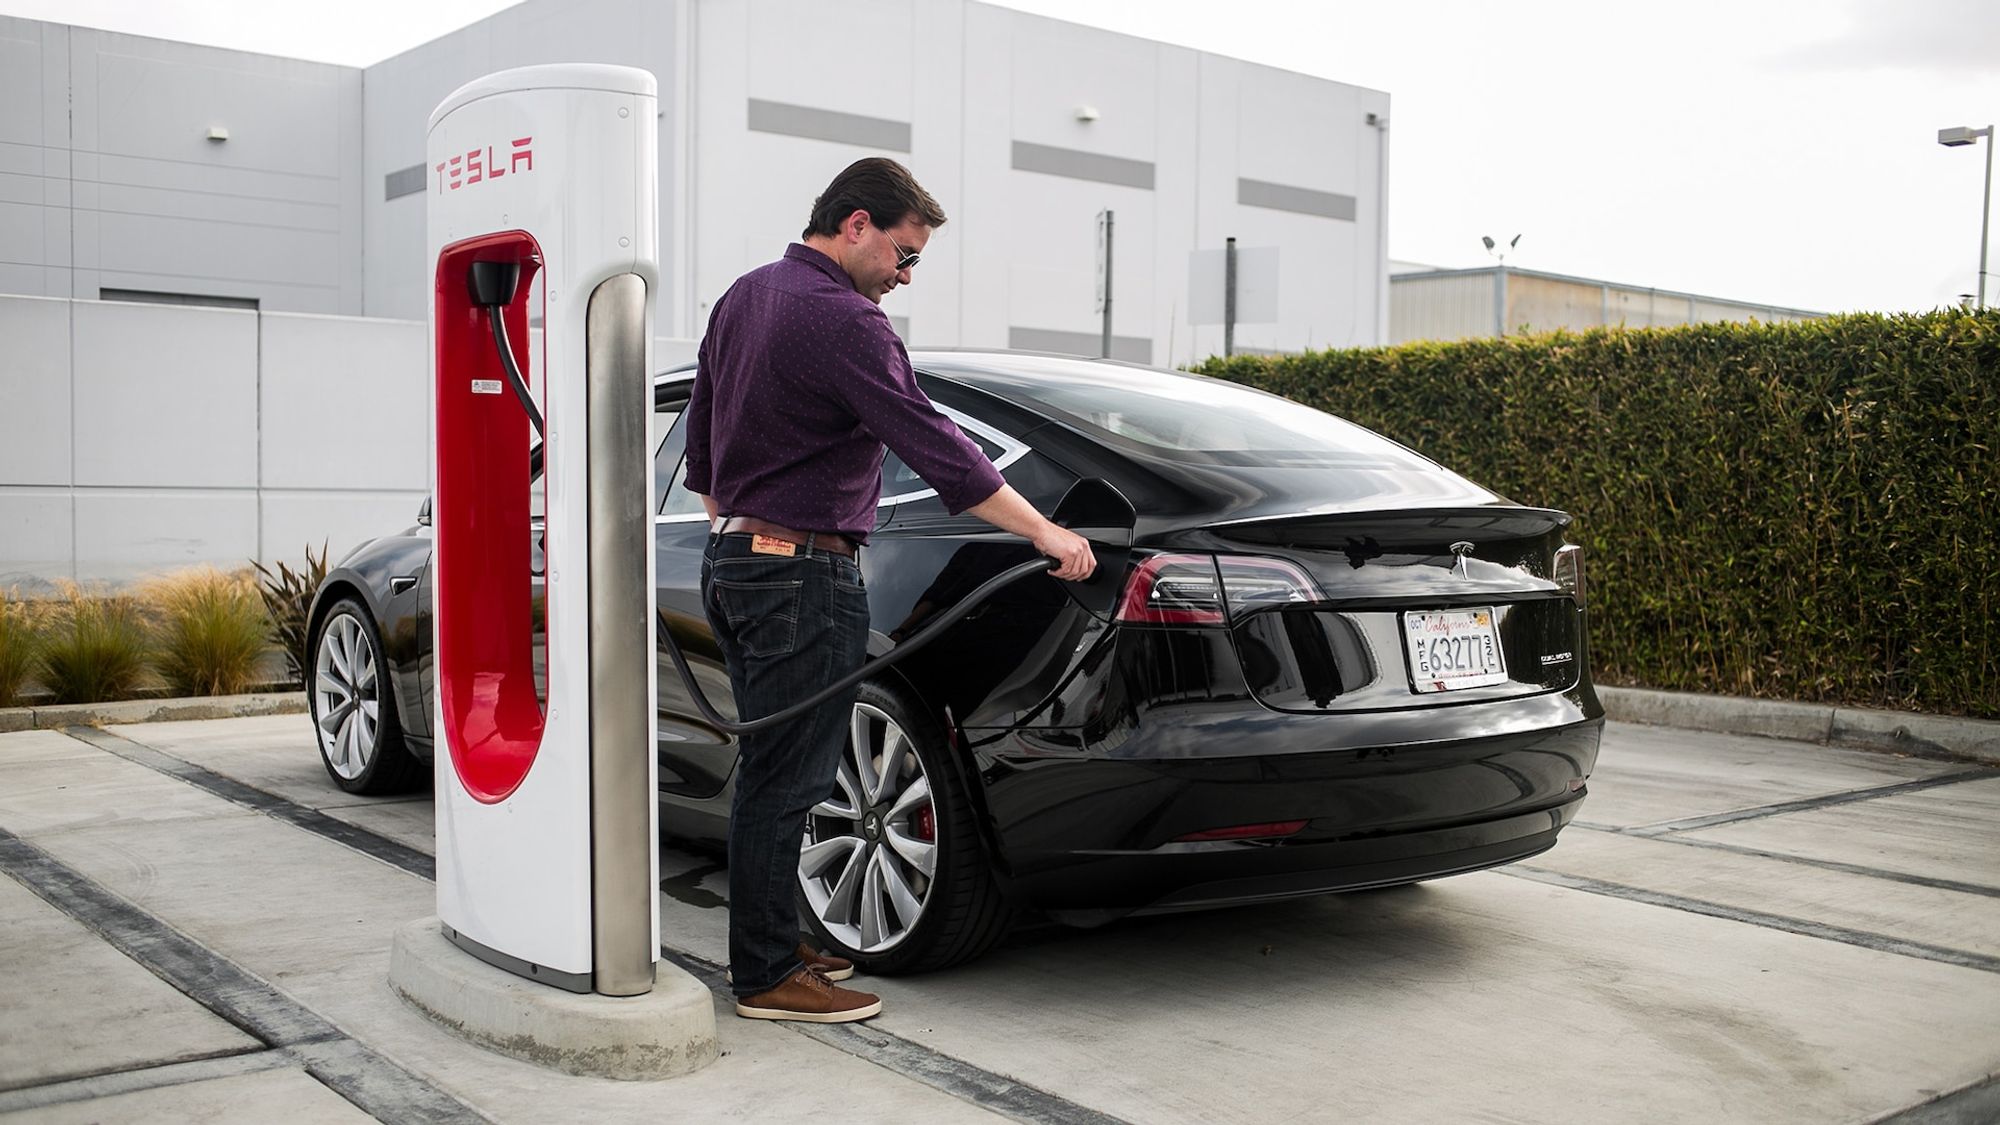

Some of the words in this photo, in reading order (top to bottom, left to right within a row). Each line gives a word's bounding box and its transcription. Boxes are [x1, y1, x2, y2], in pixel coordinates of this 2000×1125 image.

[436, 137, 532, 195] TESLA
[1425, 614, 1474, 636] Californi
[1417, 639, 1429, 671] MFG
[1429, 635, 1484, 671] 63277
[1484, 635, 1495, 667] 32L
